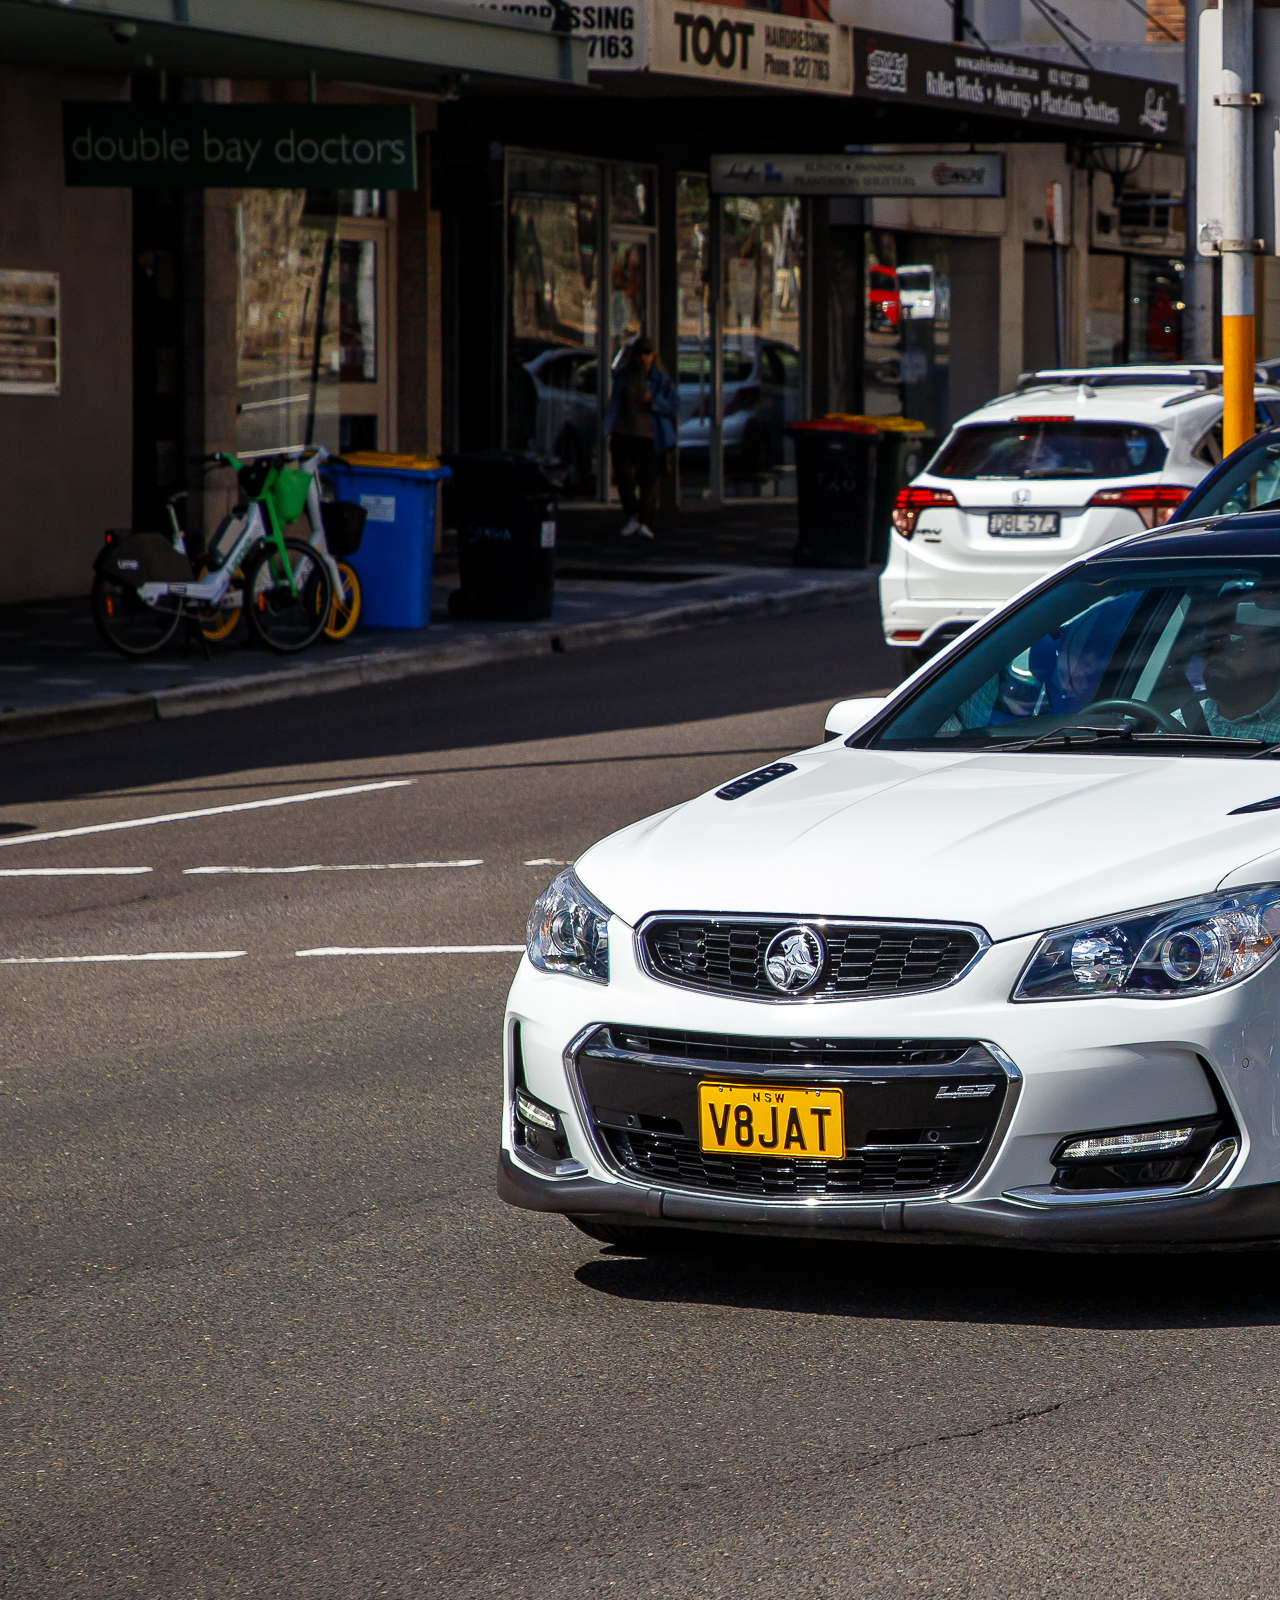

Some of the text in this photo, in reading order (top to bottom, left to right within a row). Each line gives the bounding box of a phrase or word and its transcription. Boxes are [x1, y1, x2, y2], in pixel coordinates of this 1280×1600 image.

[674, 11, 755, 71] TOOT
[765, 24, 830, 55] HAIRDRESSING
[764, 52, 790, 77] Phone
[926, 71, 955, 98] Roller
[956, 75, 984, 103] Blinds
[994, 82, 1032, 118] Awnings
[1040, 89, 1083, 118] Plantation
[1083, 96, 1120, 125] Shutters
[72, 127, 406, 173] double bay doctors
[753, 1092, 785, 1103] NSW
[708, 1101, 831, 1152] V8JAT
